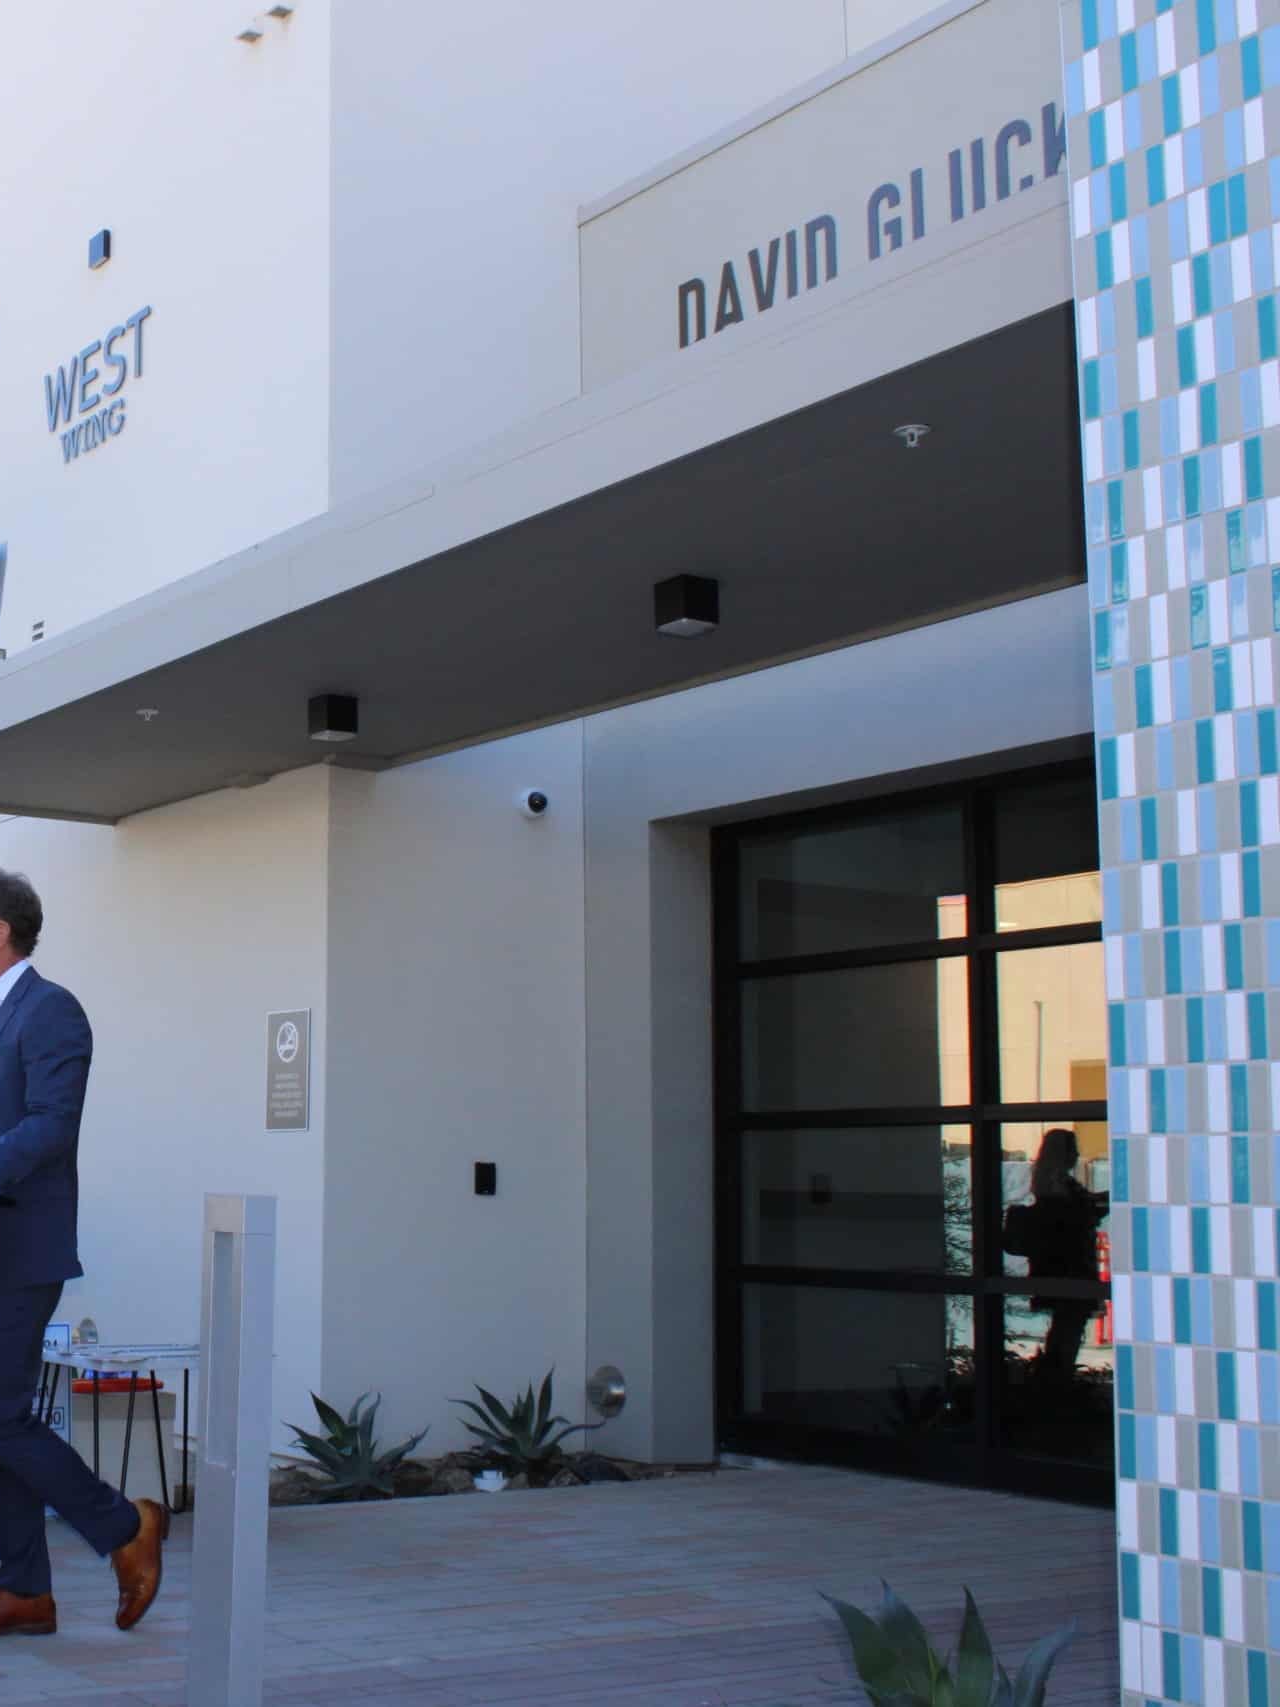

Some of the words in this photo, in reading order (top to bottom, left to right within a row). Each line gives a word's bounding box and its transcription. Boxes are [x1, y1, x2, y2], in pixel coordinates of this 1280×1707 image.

[678, 213, 838, 350] DAVID
[44, 305, 152, 433] WEST
[60, 397, 127, 465] WING
